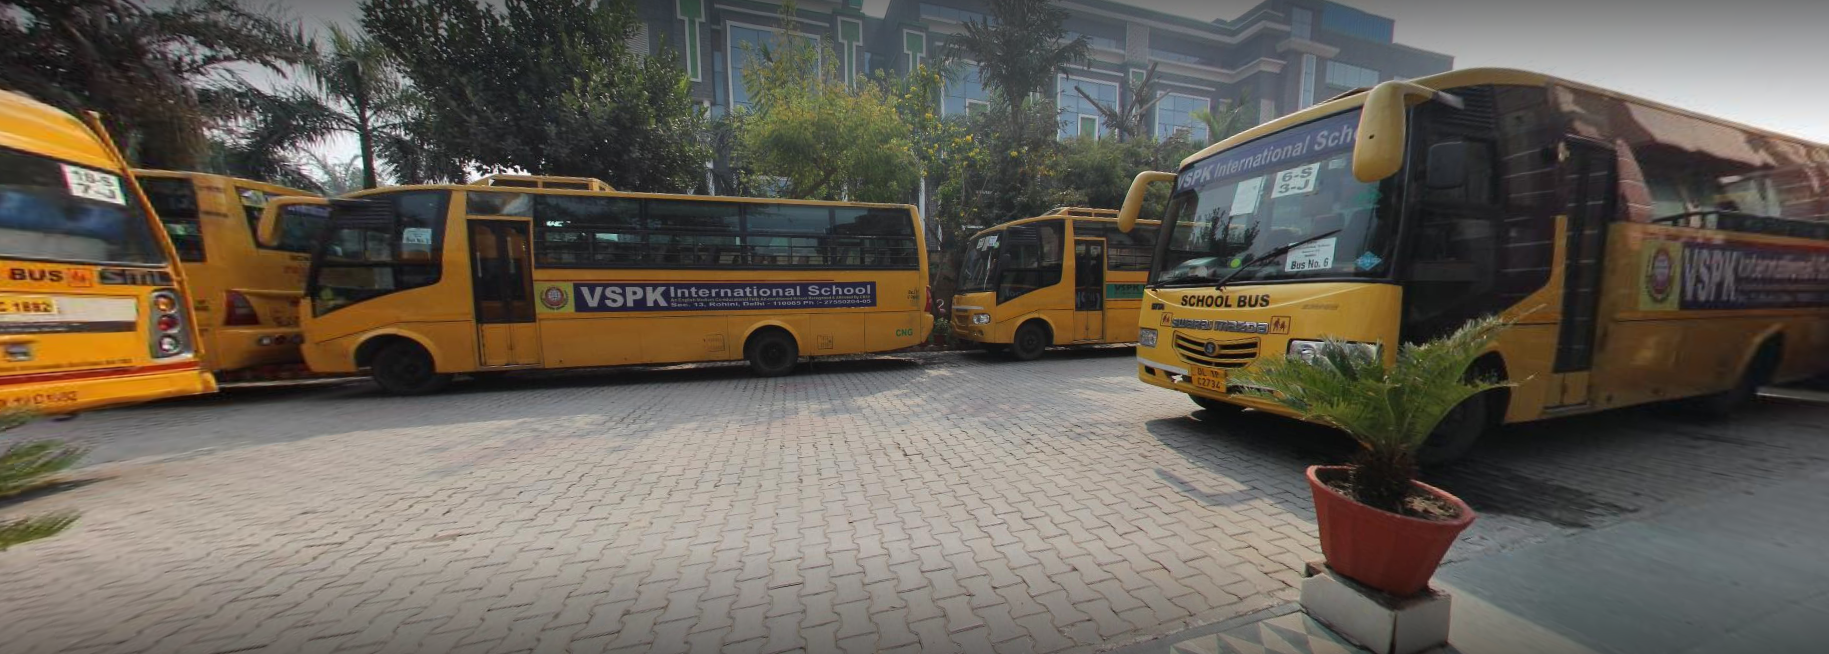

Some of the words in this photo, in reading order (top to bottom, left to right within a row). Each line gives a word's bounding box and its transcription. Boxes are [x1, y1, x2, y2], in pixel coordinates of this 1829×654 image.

[1179, 168, 1213, 189] VSPK
[1214, 140, 1309, 178] International
[1314, 124, 1358, 151] Sch
[1282, 167, 1313, 182] 6-S
[1279, 179, 1309, 194] 3-J
[1291, 260, 1306, 270] Bus
[1308, 258, 1321, 268] No.
[1324, 257, 1329, 268] 6
[10, 268, 63, 282] BUS
[1684, 249, 1737, 301] VSPK
[579, 286, 668, 307] VSPK
[670, 285, 800, 298] International
[808, 284, 871, 296] School
[1181, 294, 1232, 307] SCHOOL
[1236, 294, 1270, 308] BUS
[895, 329, 913, 337] CNG
